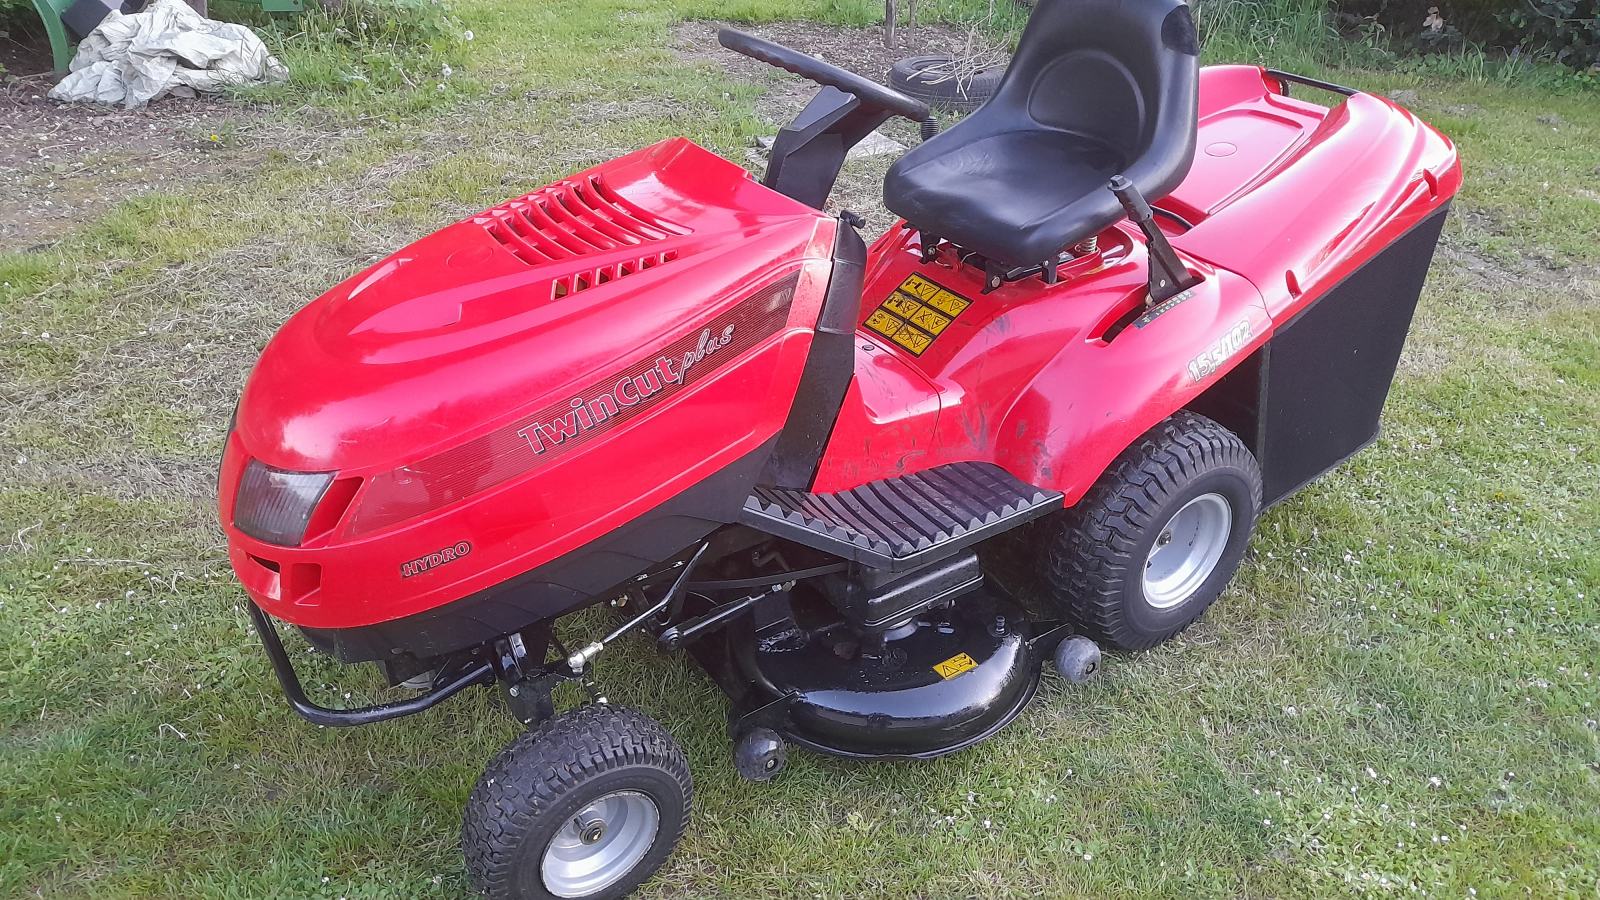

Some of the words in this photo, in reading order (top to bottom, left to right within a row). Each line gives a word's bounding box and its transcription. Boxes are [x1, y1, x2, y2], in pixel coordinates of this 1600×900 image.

[518, 356, 680, 455] TwinCut
[677, 323, 735, 384] plus
[402, 541, 470, 577] HYDRO
